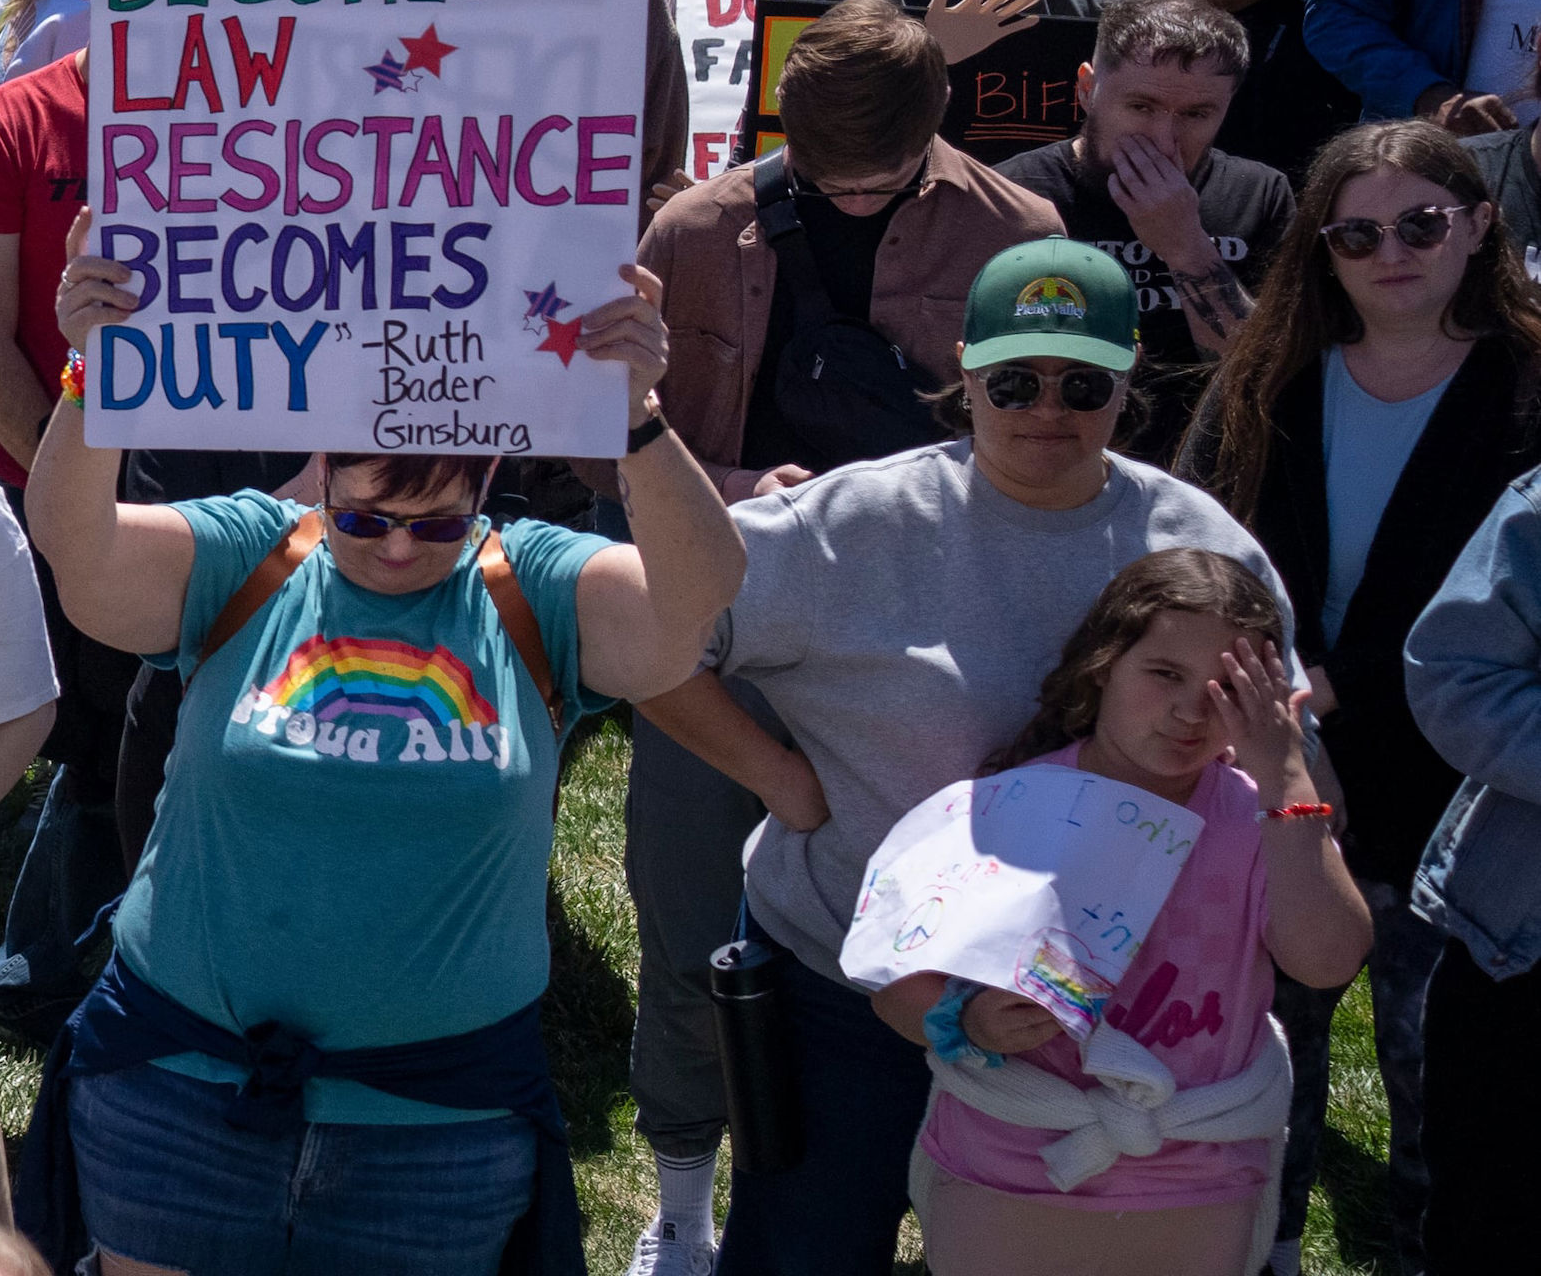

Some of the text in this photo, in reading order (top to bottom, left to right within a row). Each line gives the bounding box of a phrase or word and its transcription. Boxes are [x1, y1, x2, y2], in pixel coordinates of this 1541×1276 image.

[111, 14, 297, 114] LAW
[102, 115, 638, 215] RESISTANCE
[101, 222, 493, 314] BECOMES
[373, 366, 496, 405] Bader
[373, 409, 533, 454] Ginsburg
[231, 684, 511, 770] Proud Ally
